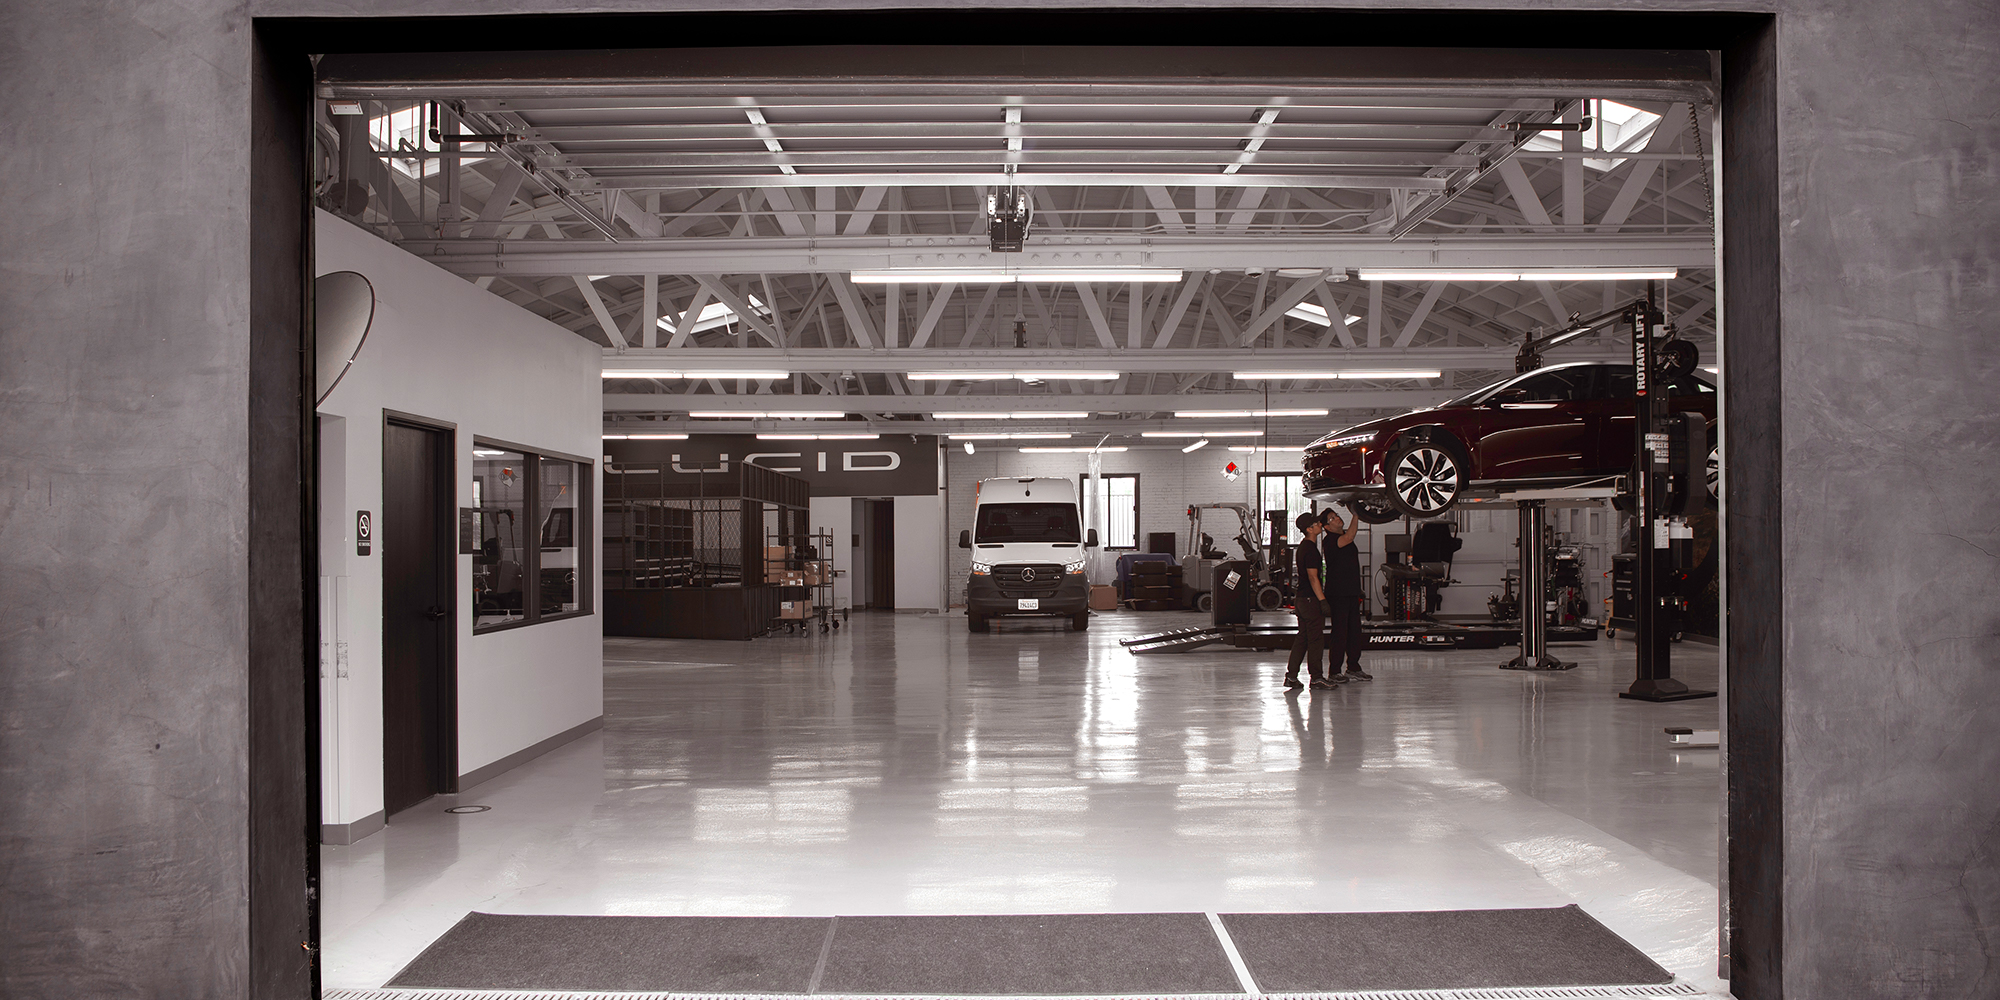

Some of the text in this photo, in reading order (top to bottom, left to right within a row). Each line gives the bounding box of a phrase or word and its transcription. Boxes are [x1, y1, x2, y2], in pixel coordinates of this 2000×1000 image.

[1635, 313, 1646, 390] ROTARY LIFT
[1369, 635, 1415, 643] HUNTER
